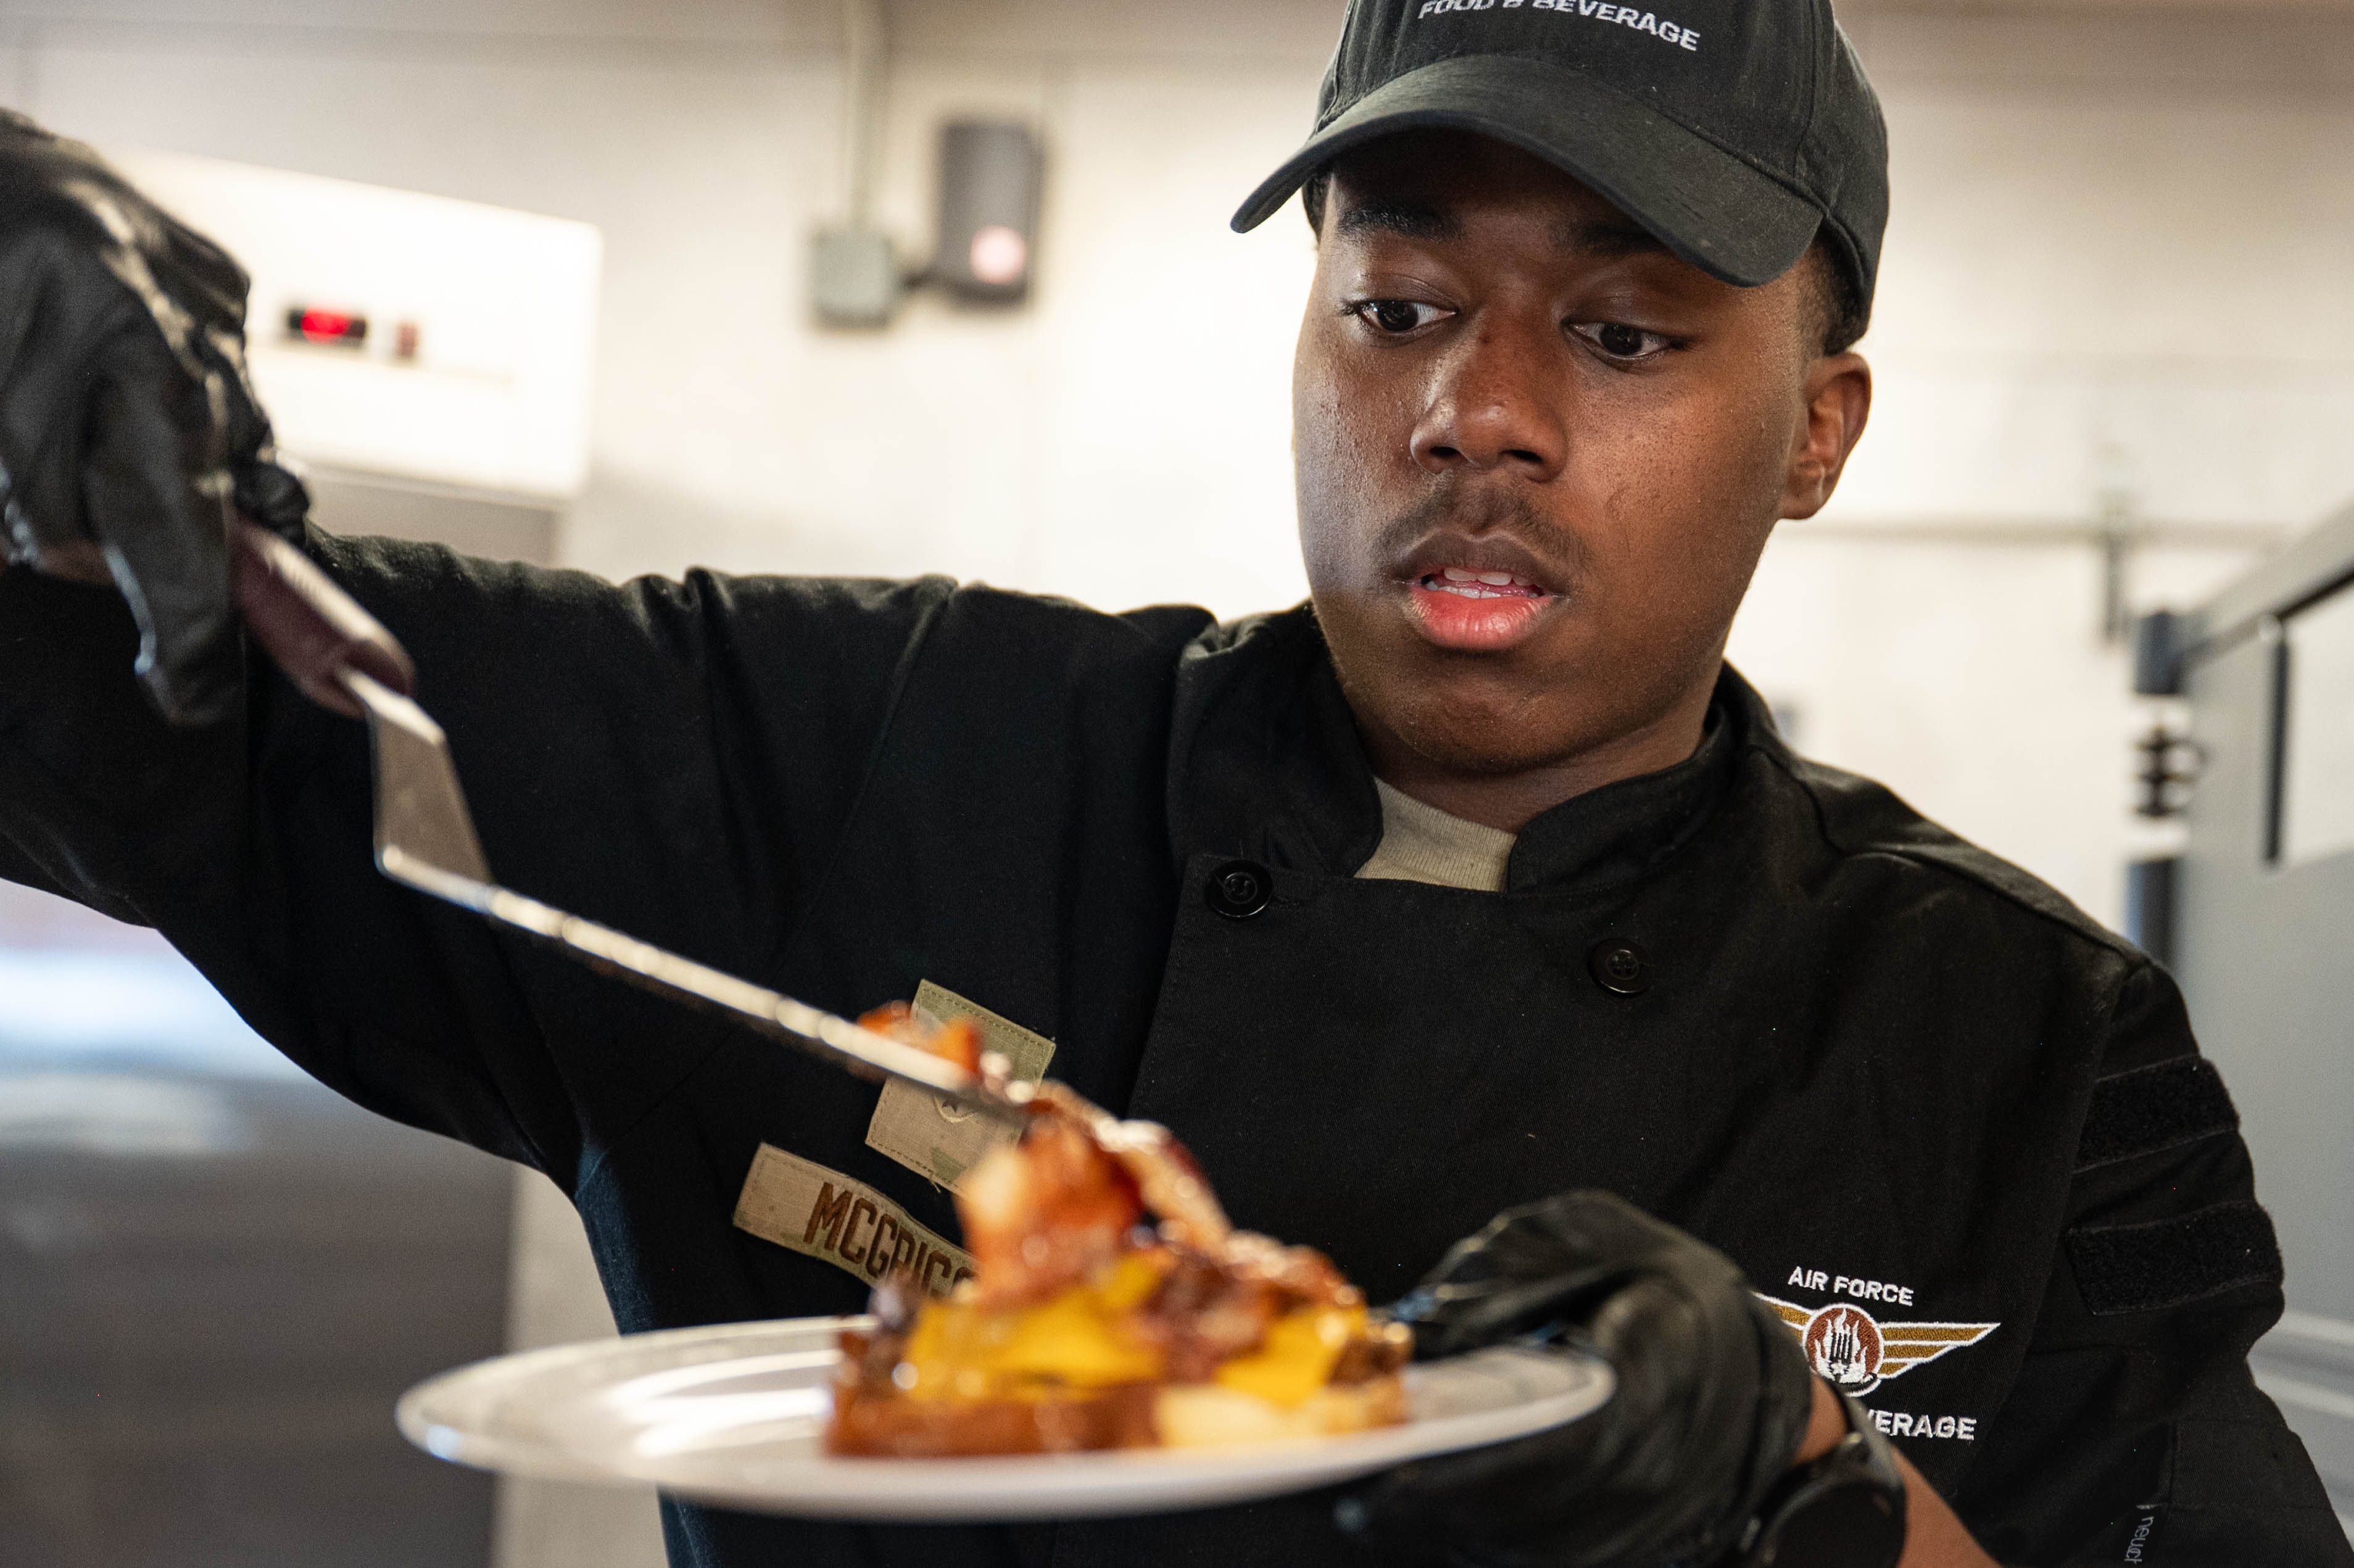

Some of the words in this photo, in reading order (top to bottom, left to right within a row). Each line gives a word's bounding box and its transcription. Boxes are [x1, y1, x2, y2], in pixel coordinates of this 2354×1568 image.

[1532, 0, 1701, 51] BEVERAGE
[803, 1181, 980, 1299] MCGRIG
[1788, 1266, 1829, 1292] AIR
[1833, 1275, 1914, 1306] FORCE
[1867, 1408, 1977, 1441] ERAGE
